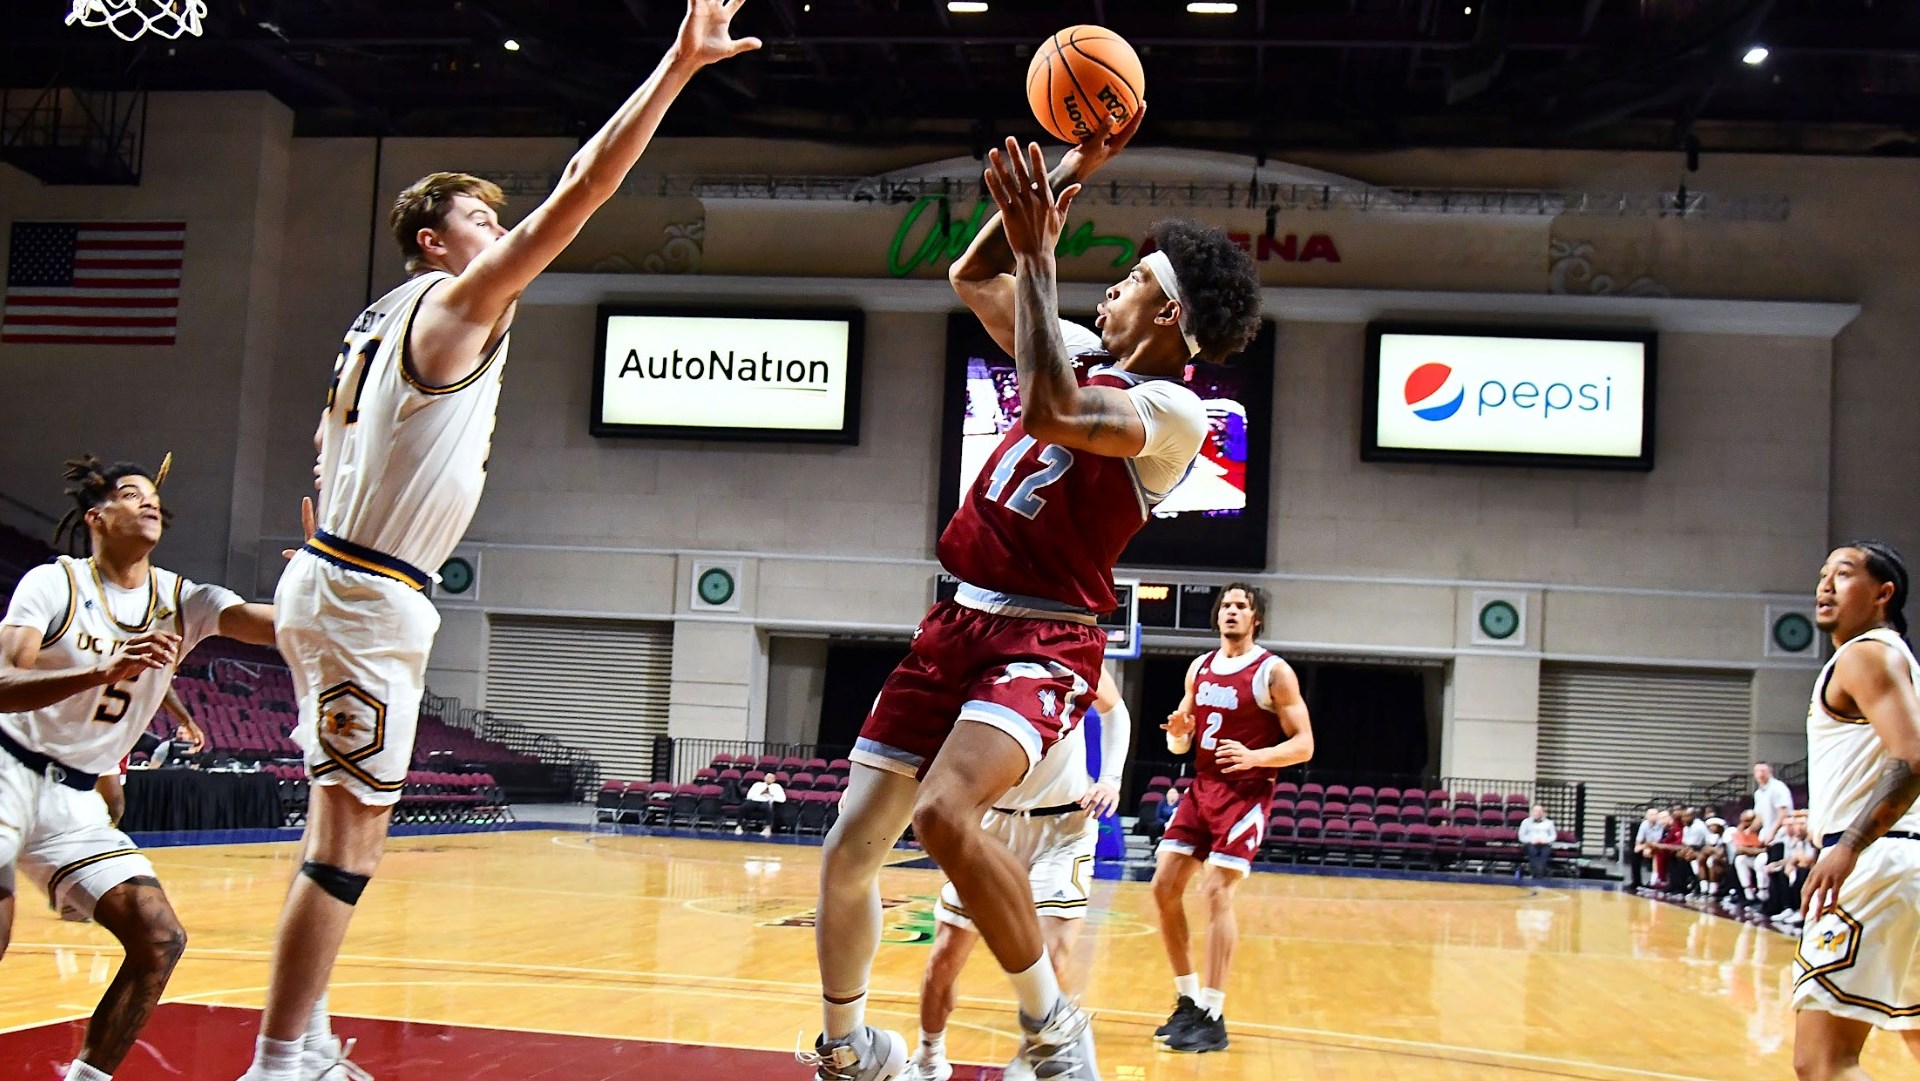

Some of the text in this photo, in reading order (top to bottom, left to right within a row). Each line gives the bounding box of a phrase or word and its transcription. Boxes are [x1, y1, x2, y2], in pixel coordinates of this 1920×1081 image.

[1063, 92, 1094, 140] lson
[618, 348, 829, 384] AutoNation
[1478, 376, 1612, 418] pepsi
[985, 434, 1075, 520] 42
[93, 674, 133, 724] 5
[1200, 711, 1223, 751] 2
